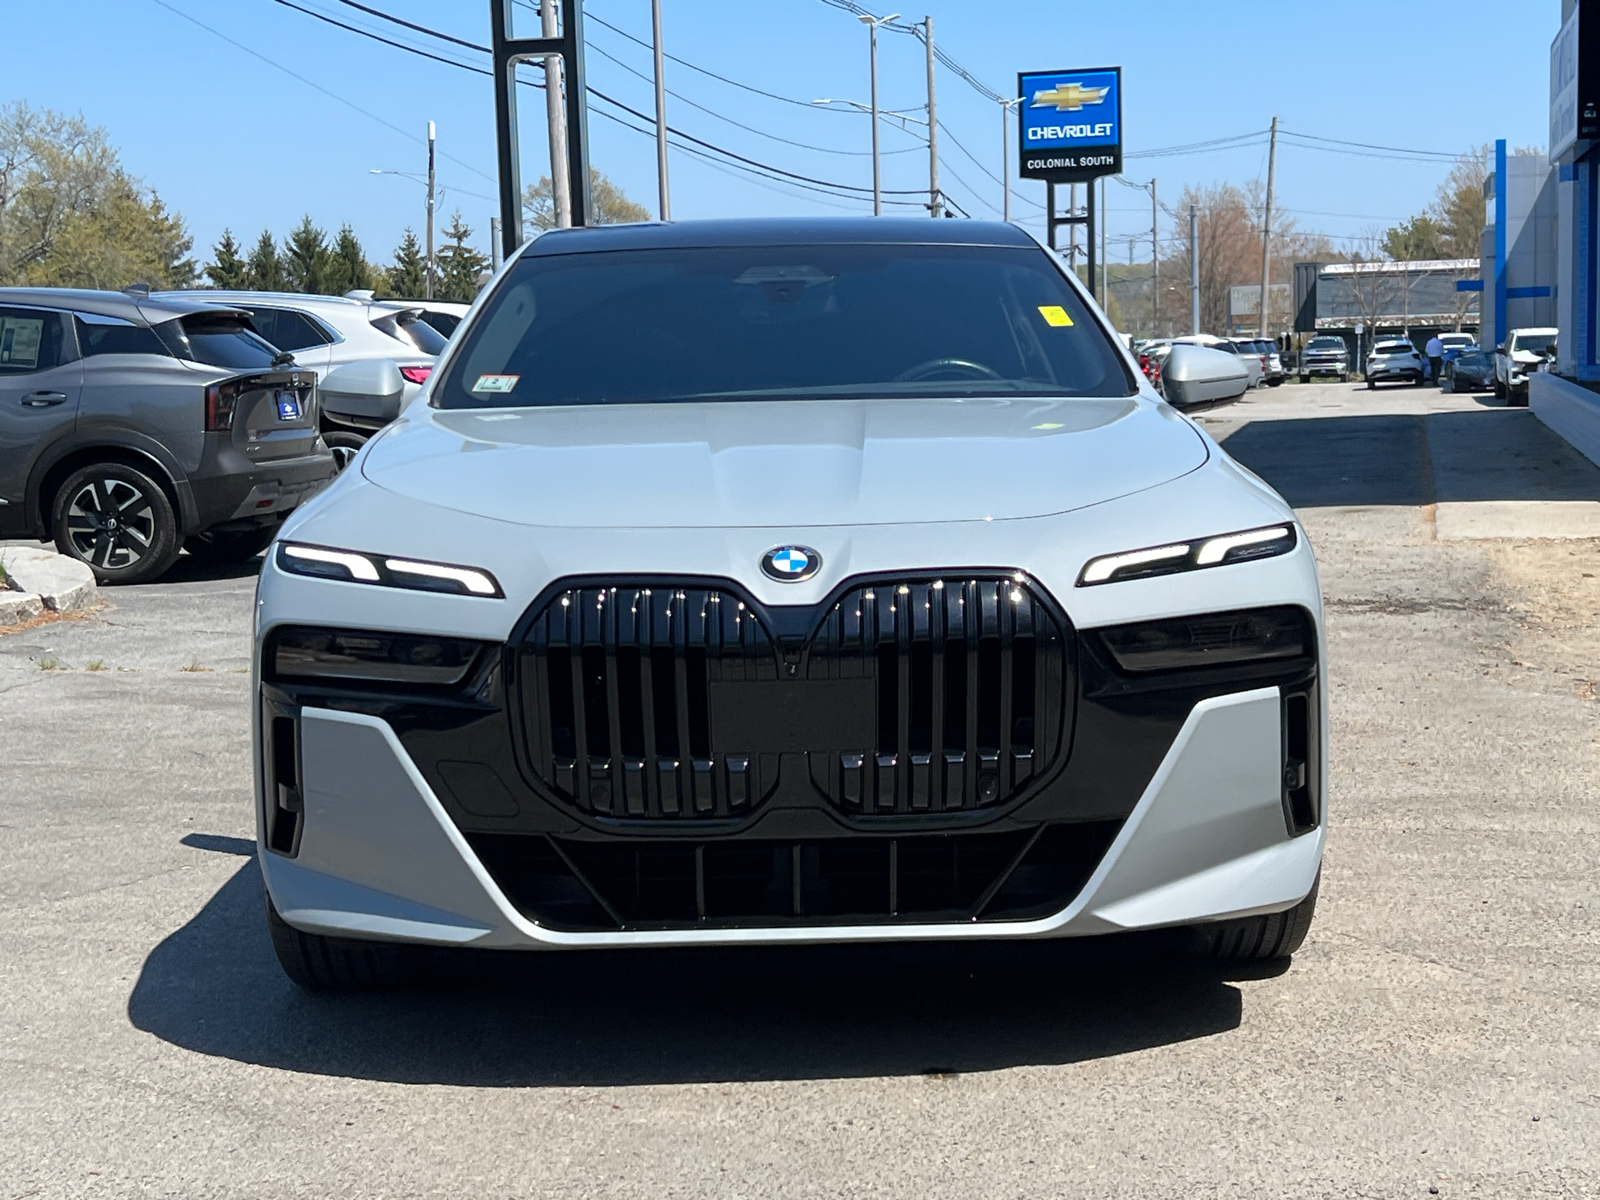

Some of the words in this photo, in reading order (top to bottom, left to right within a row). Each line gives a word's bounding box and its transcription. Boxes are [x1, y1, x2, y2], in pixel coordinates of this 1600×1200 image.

[1028, 123, 1113, 139] CHEVROLET
[1027, 158, 1077, 169] COLONIAL
[1080, 156, 1114, 166] SOUTH
